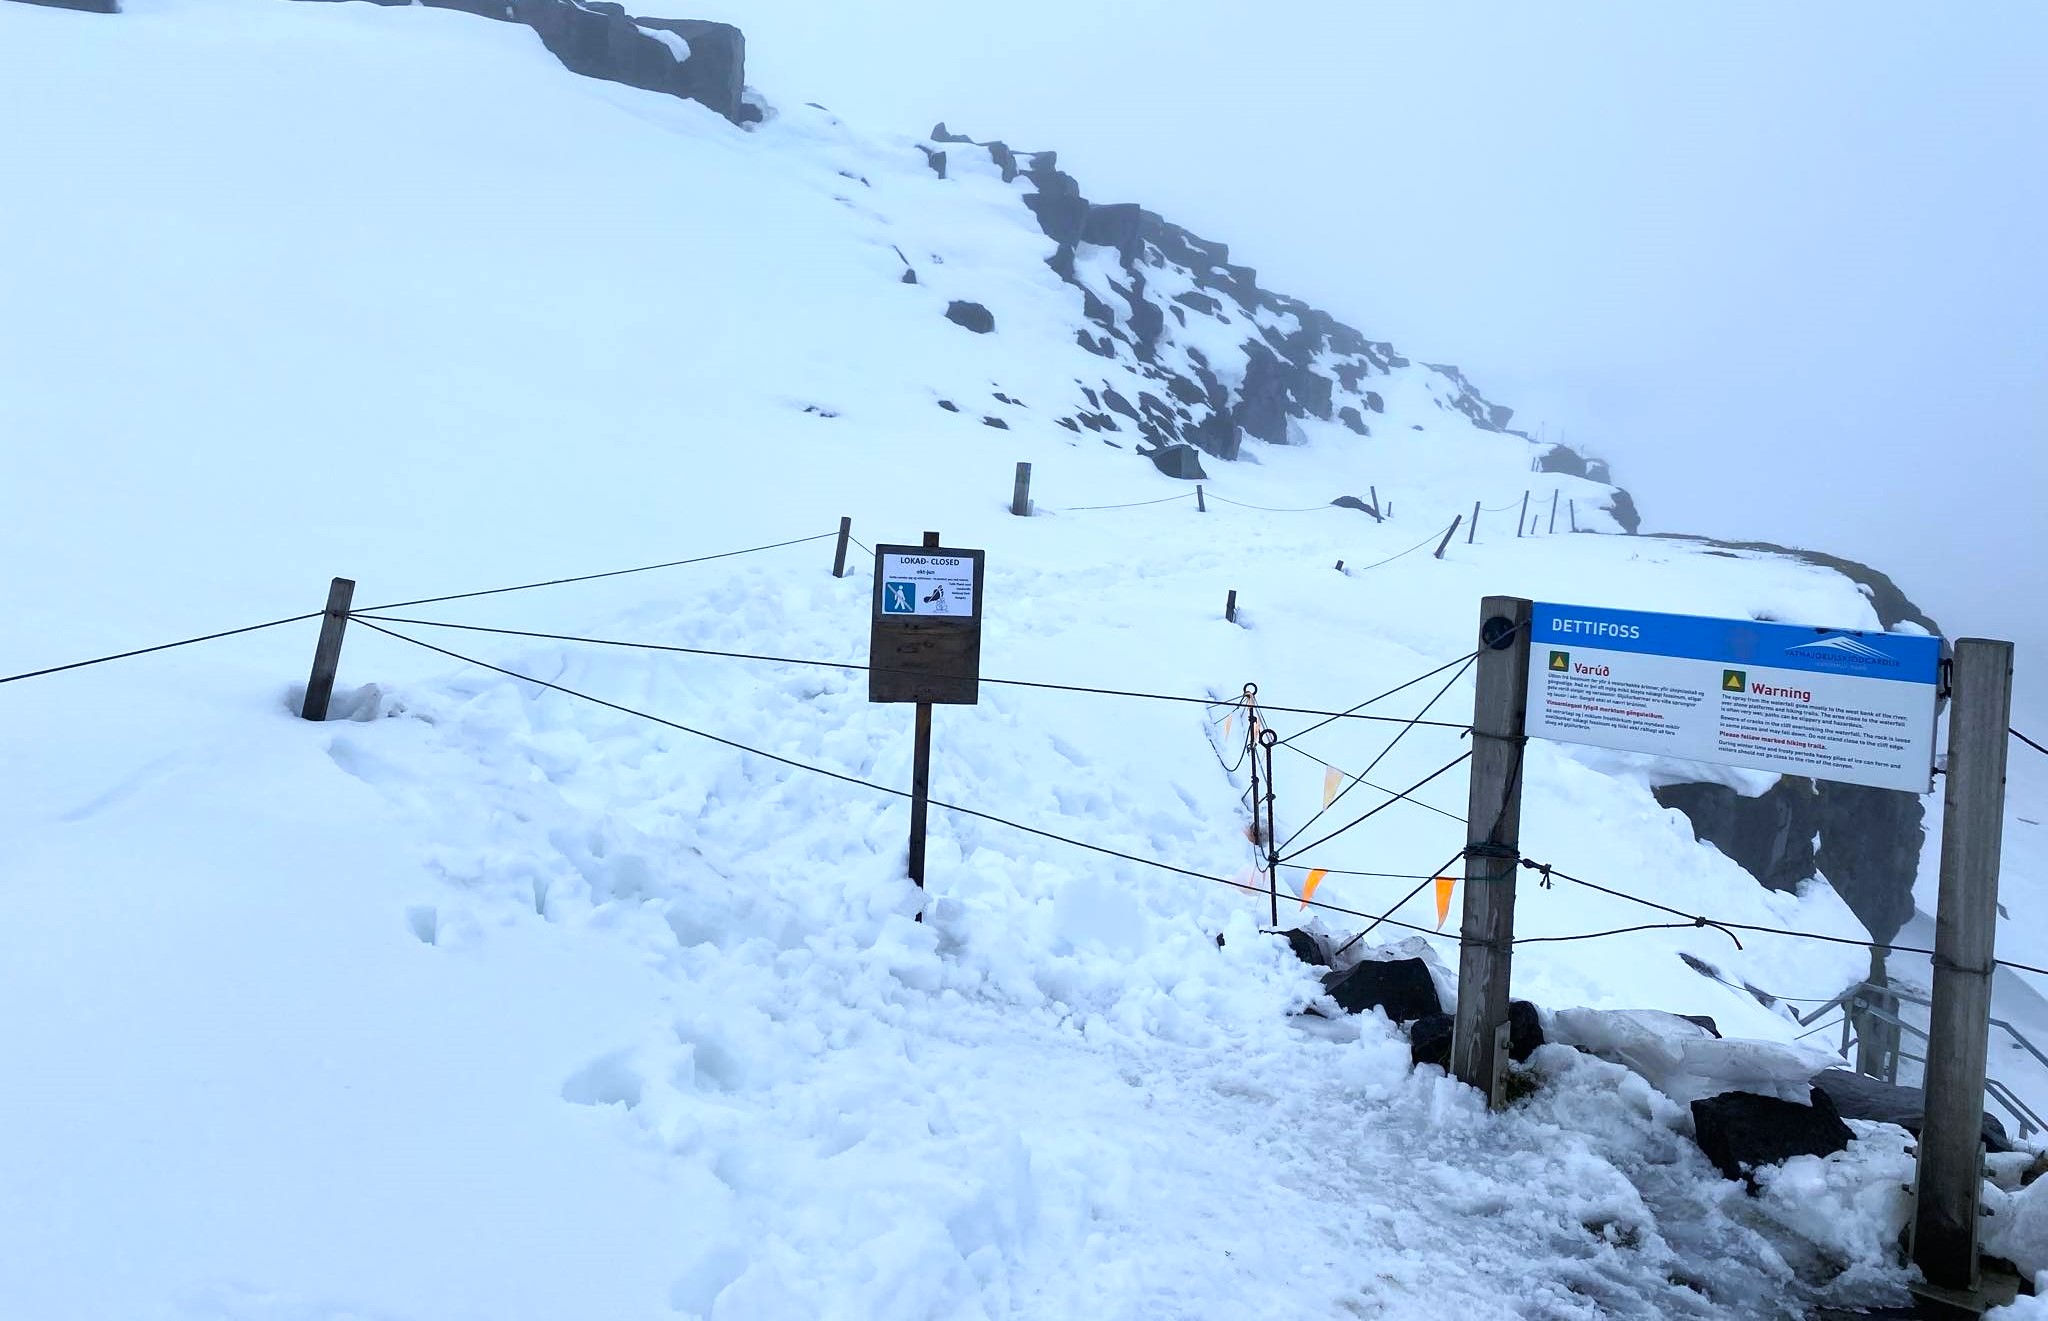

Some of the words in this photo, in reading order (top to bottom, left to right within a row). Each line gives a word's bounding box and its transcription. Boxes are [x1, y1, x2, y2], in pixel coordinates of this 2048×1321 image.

[931, 558, 960, 566] CLOSED
[1552, 618, 1640, 639] DETTIFOSS
[1574, 662, 1610, 676] Varúð
[1752, 683, 1811, 702] Warning
[1749, 703, 1774, 711] platforms
[1786, 707, 1802, 715] hiking
[1809, 705, 1827, 713] mostly
[1799, 716, 1820, 724] slippery
[1792, 725, 1823, 733] overlooking
[1720, 730, 1739, 738] Please
[1741, 733, 1760, 741] follow
[1787, 739, 1806, 748] hiking
[1808, 742, 1827, 750] trails.
[1719, 739, 1736, 748] During
[1779, 747, 1793, 755] frosty
[1816, 753, 1832, 761] heavy
